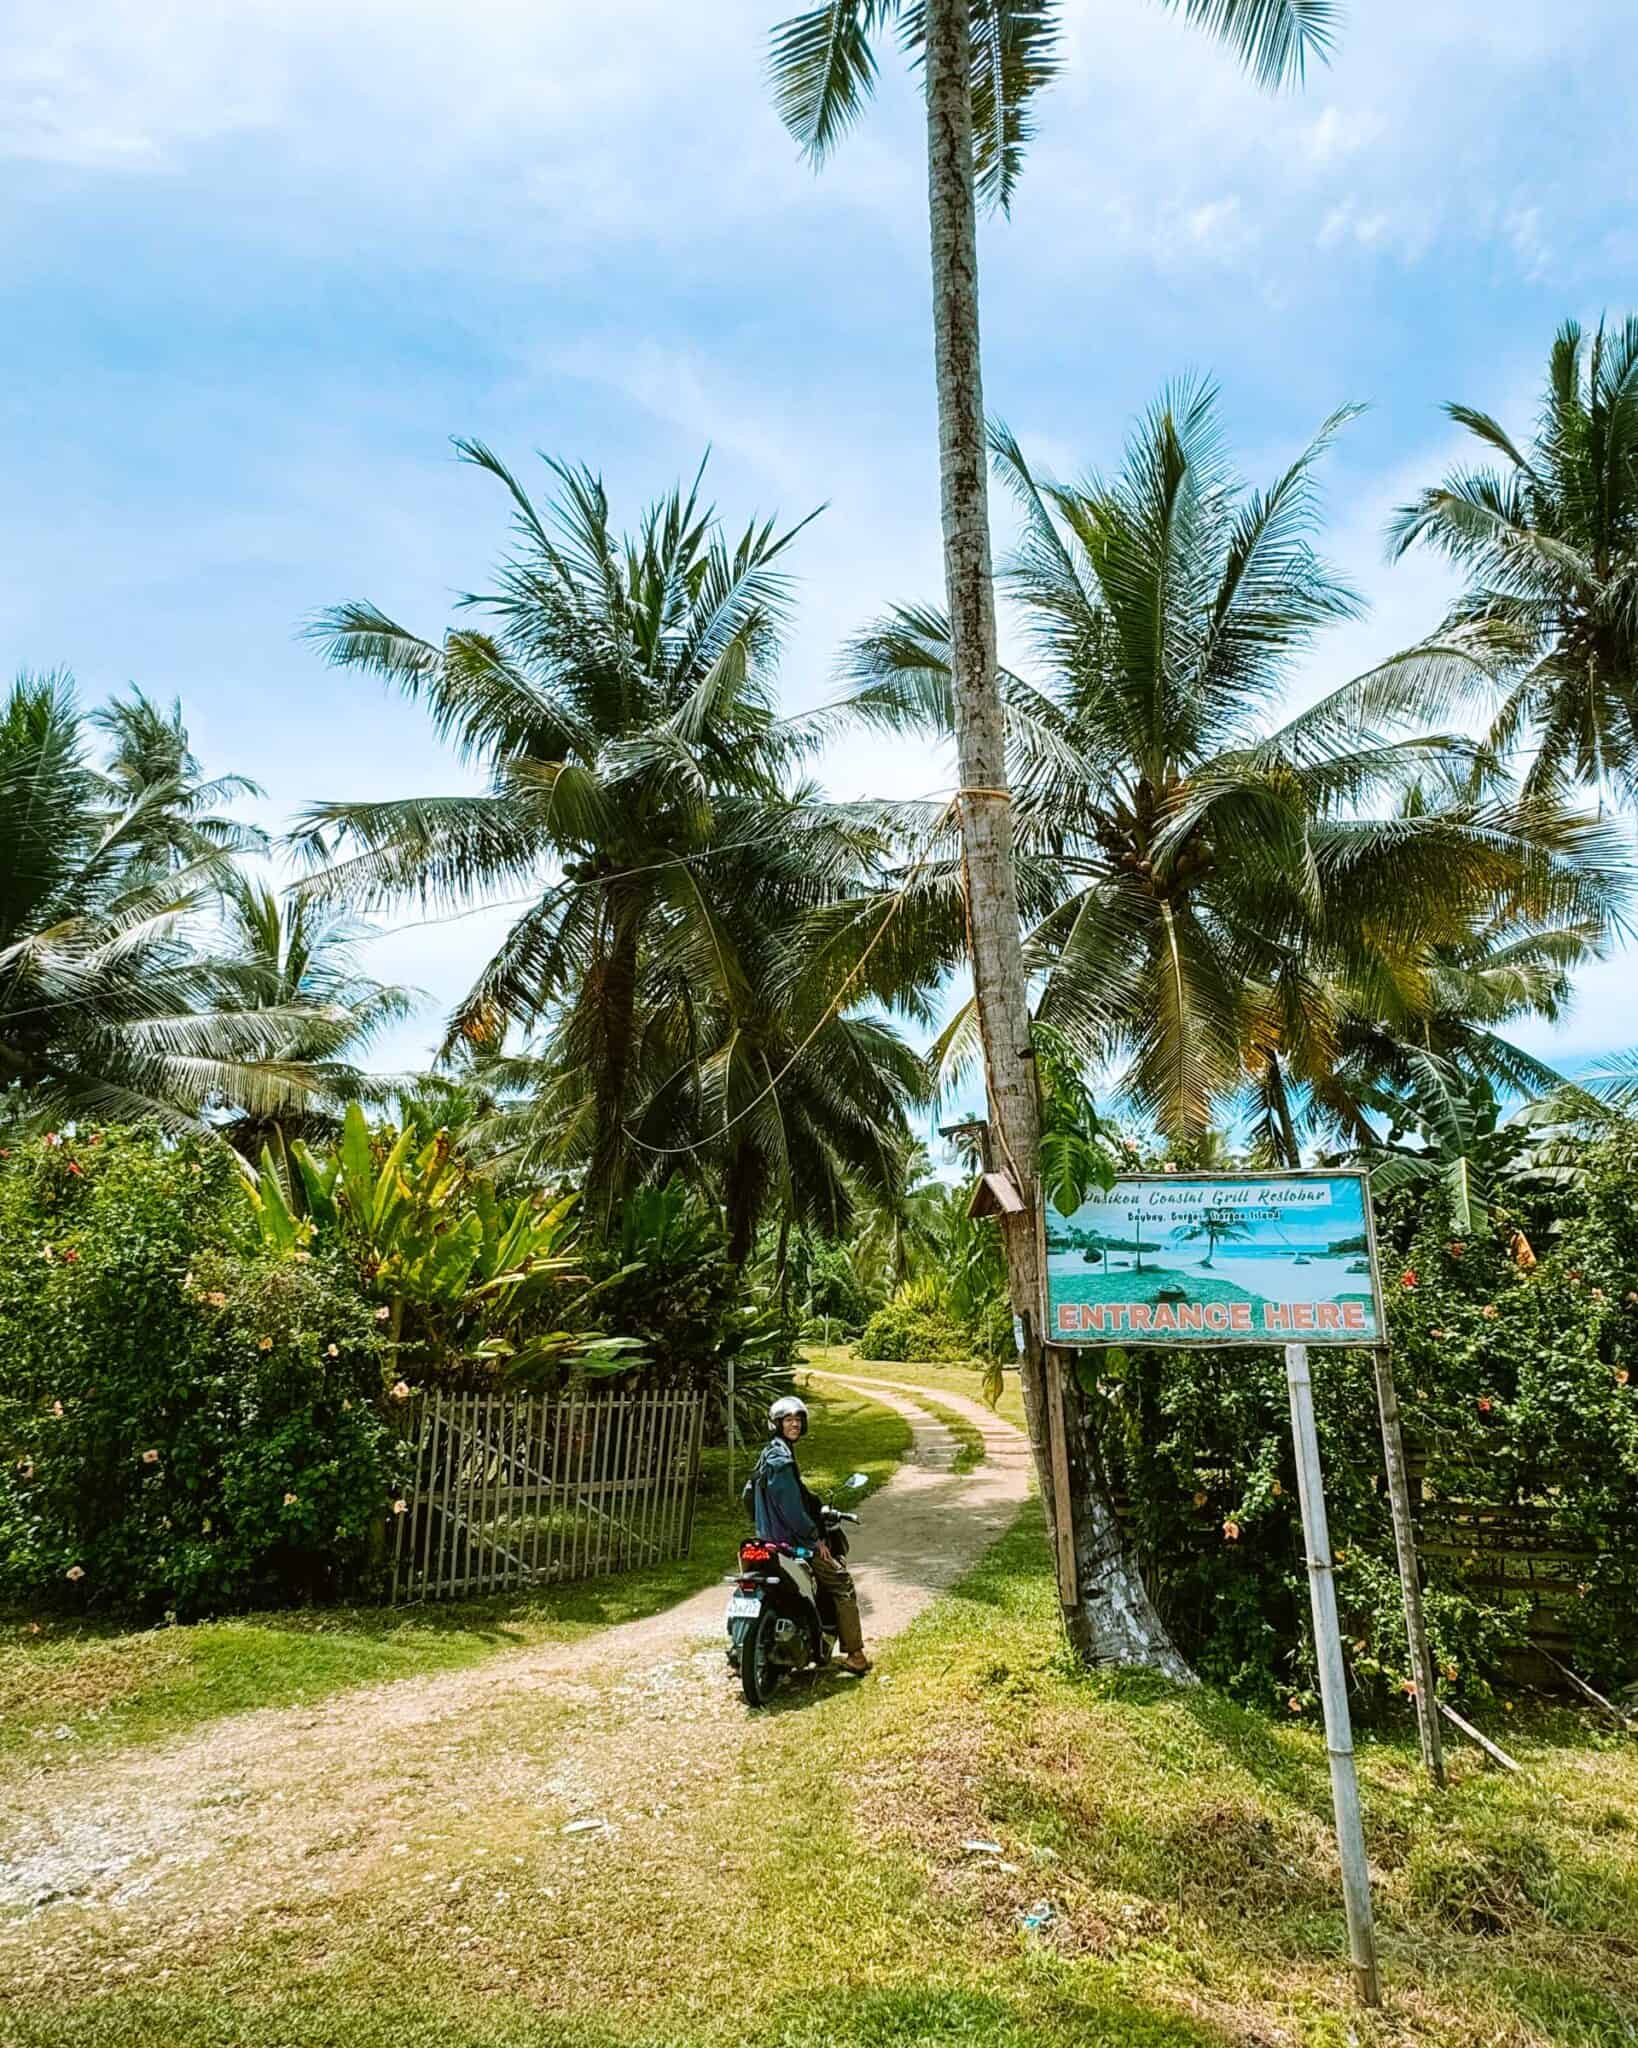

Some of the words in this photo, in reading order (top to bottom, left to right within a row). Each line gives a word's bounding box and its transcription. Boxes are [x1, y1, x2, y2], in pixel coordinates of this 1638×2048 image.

[1149, 1191, 1204, 1206] Coastal
[1212, 1191, 1249, 1206] Grill
[1258, 1189, 1325, 1205] Restobar
[1249, 1208, 1280, 1220] Island
[1057, 1303, 1253, 1331] ENTRANCE
[1263, 1302, 1367, 1330] HERE
